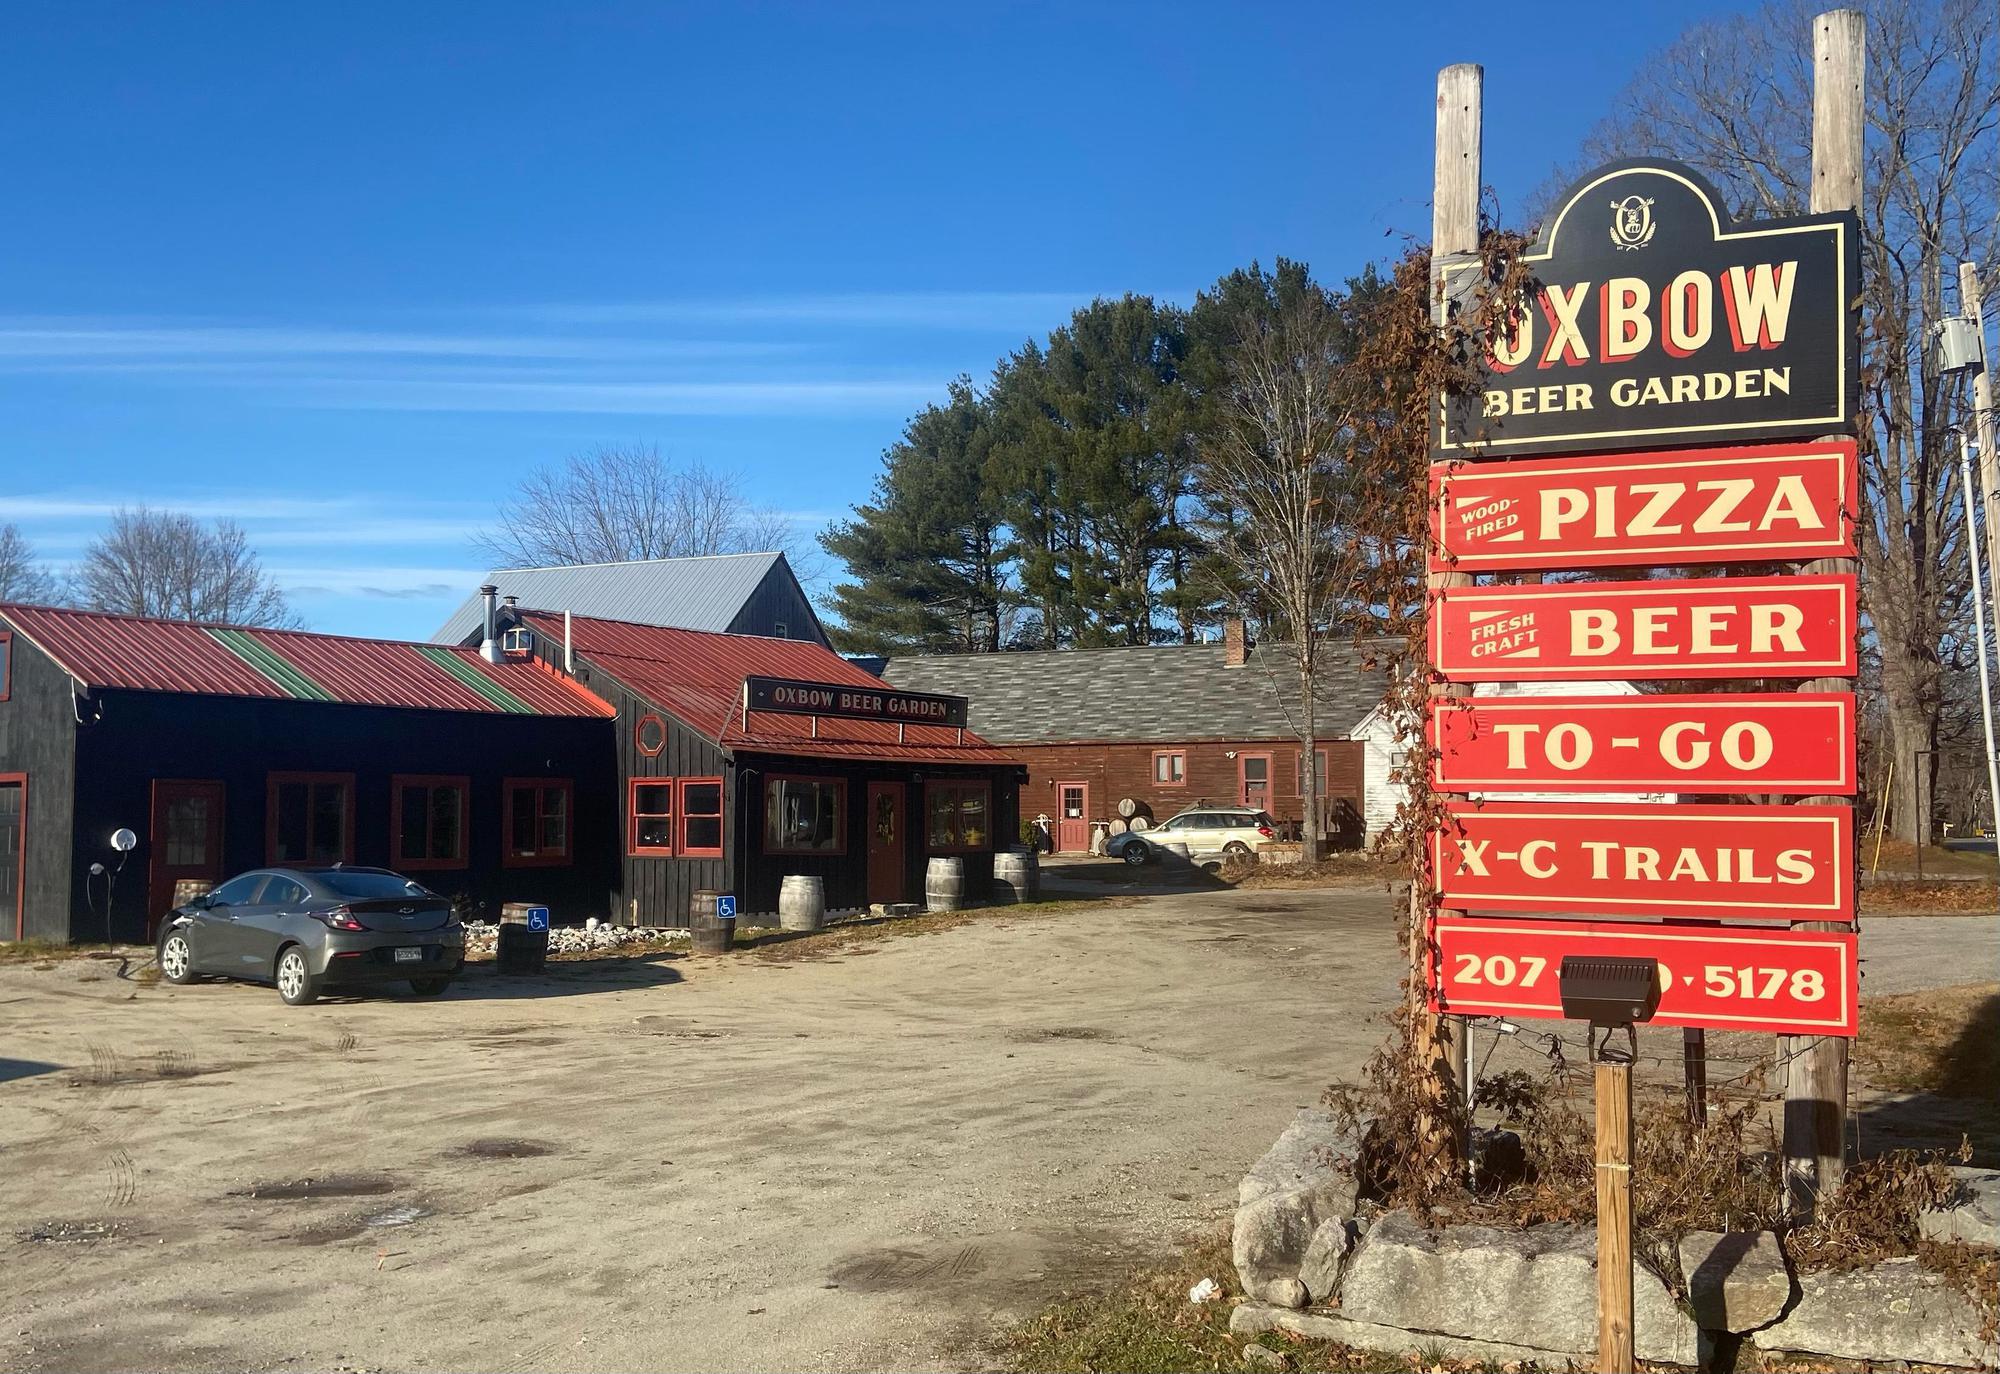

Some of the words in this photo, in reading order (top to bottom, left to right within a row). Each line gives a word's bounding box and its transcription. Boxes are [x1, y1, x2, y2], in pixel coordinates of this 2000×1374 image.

[1485, 261, 1798, 374] OXBOW
[1483, 384, 1594, 418] BEER
[1610, 367, 1791, 408] GARDEN
[1461, 498, 1519, 524] WOOD-
[1465, 513, 1519, 542] FIRED
[1538, 475, 1825, 541] PIZZA
[1470, 612, 1535, 642] FRESH
[1470, 628, 1540, 659] CRAFT
[1569, 604, 1807, 657] BEER
[774, 686, 834, 707] OXBOW
[841, 694, 882, 712] BEER
[888, 698, 947, 717] GARDEN
[1454, 839, 1558, 880] X-C
[1581, 841, 1816, 886] TRAILS
[1454, 953, 1547, 988] 207
[1703, 965, 1826, 1003] 5178
